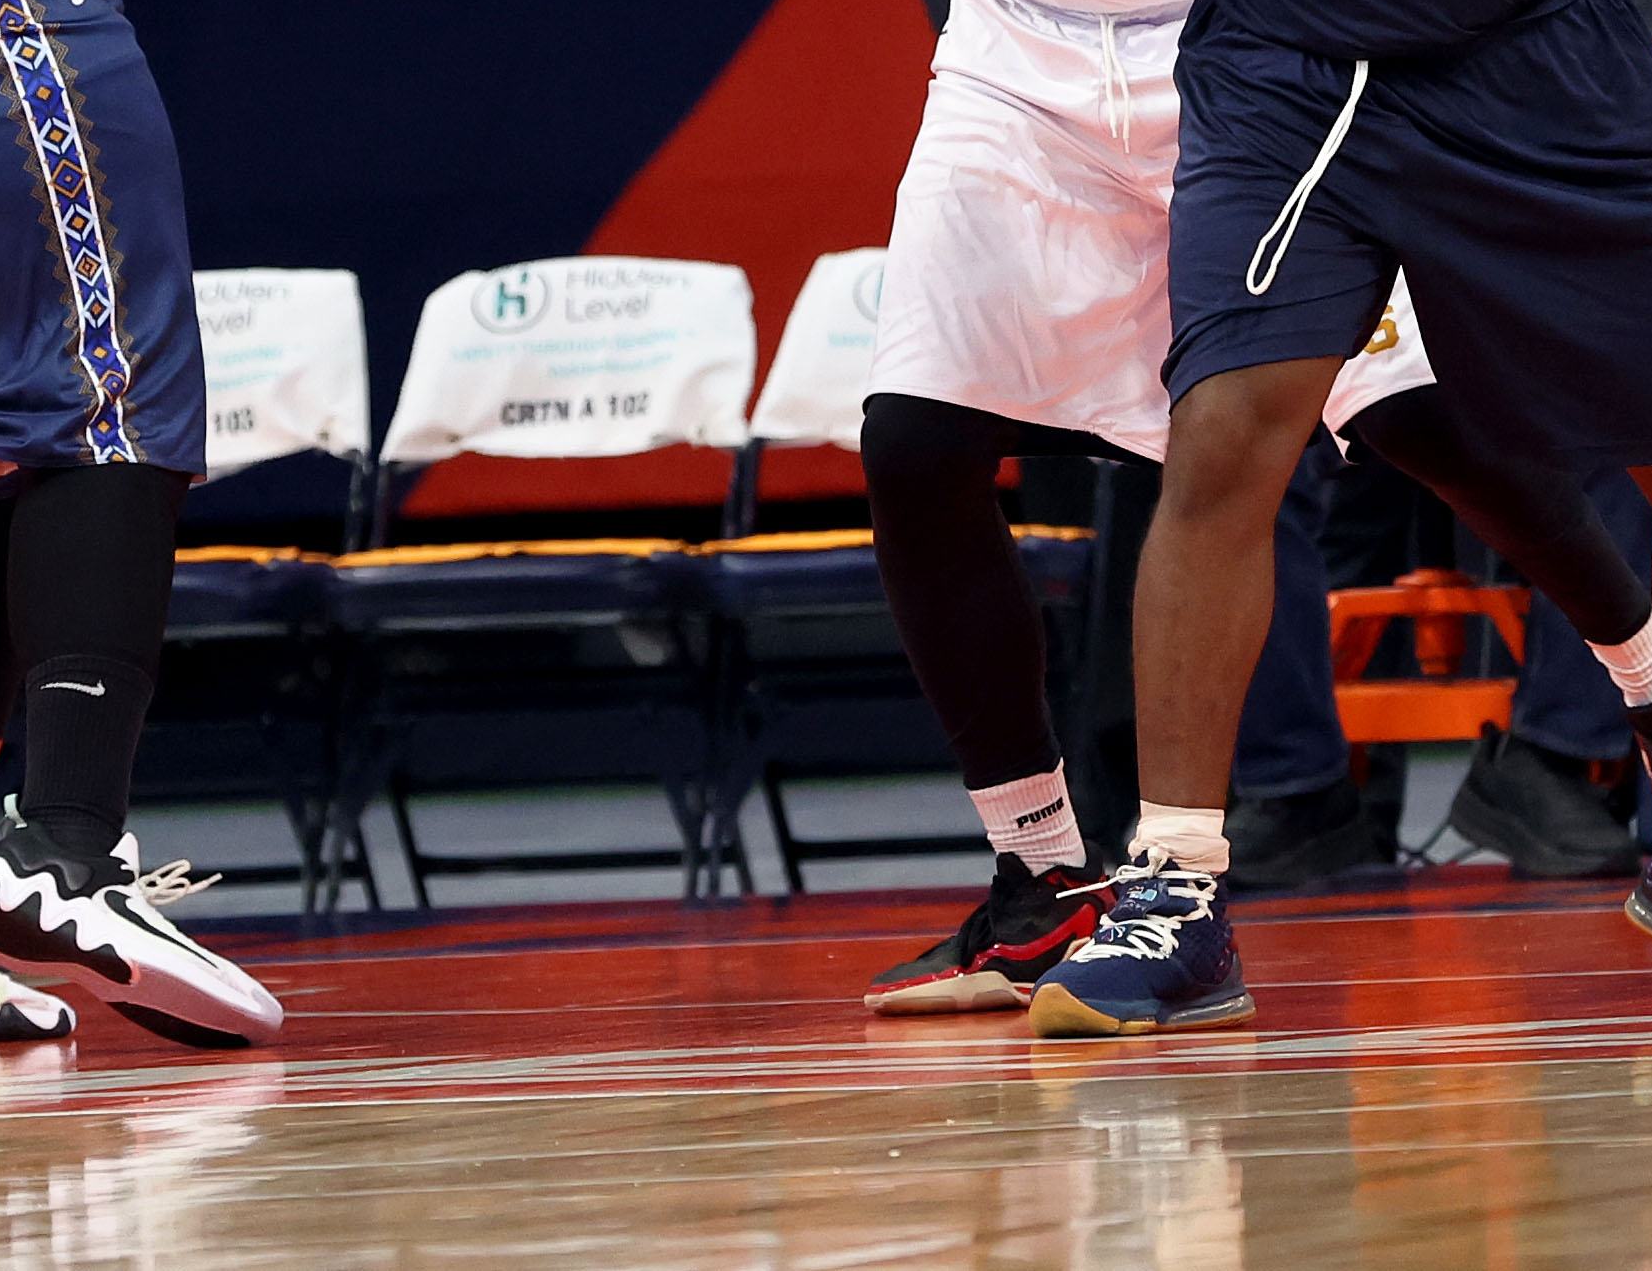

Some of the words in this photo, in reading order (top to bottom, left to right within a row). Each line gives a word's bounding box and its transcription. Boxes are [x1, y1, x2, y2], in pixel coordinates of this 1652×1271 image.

[197, 306, 253, 335] vel
[564, 292, 651, 323] Level
[1016, 796, 1064, 829] PUMA
